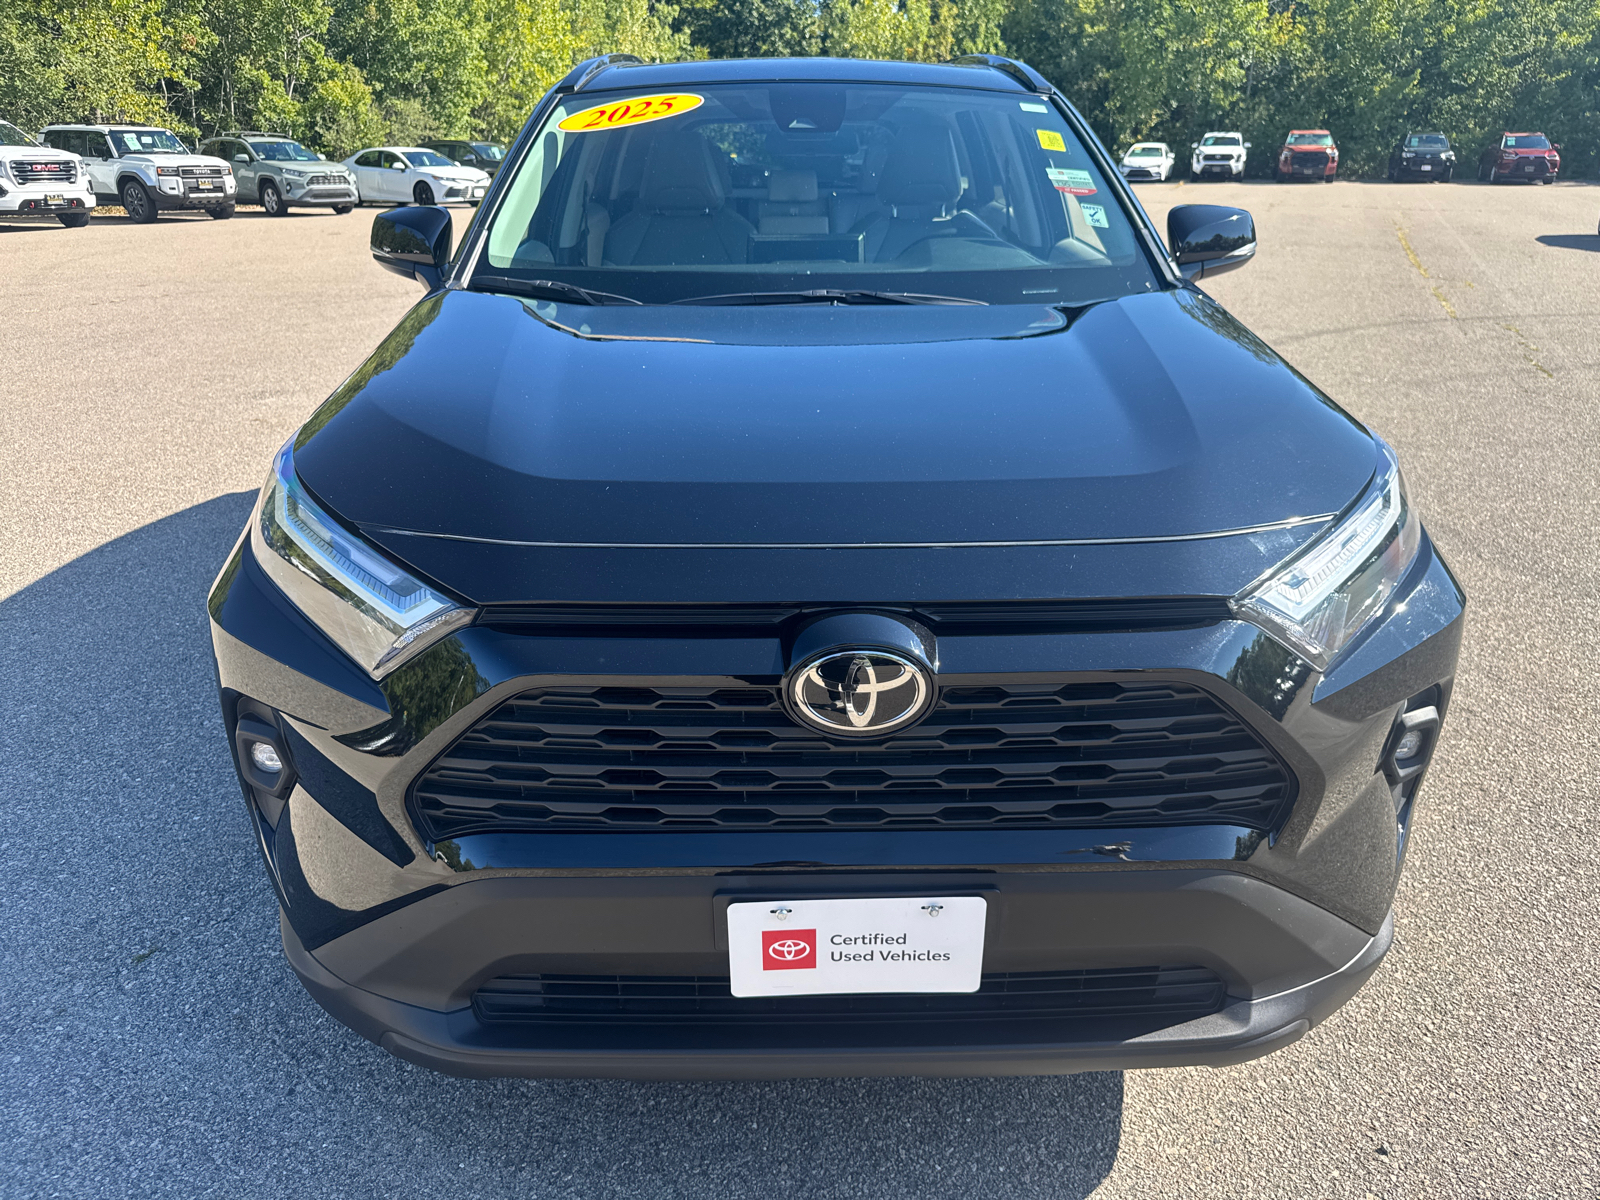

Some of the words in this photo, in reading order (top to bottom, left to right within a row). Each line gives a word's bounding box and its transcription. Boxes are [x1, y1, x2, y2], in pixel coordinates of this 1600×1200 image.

[581, 96, 679, 129] 2025
[830, 933, 907, 946] Certified
[830, 950, 874, 962] Used
[879, 950, 951, 962] Vehicles
